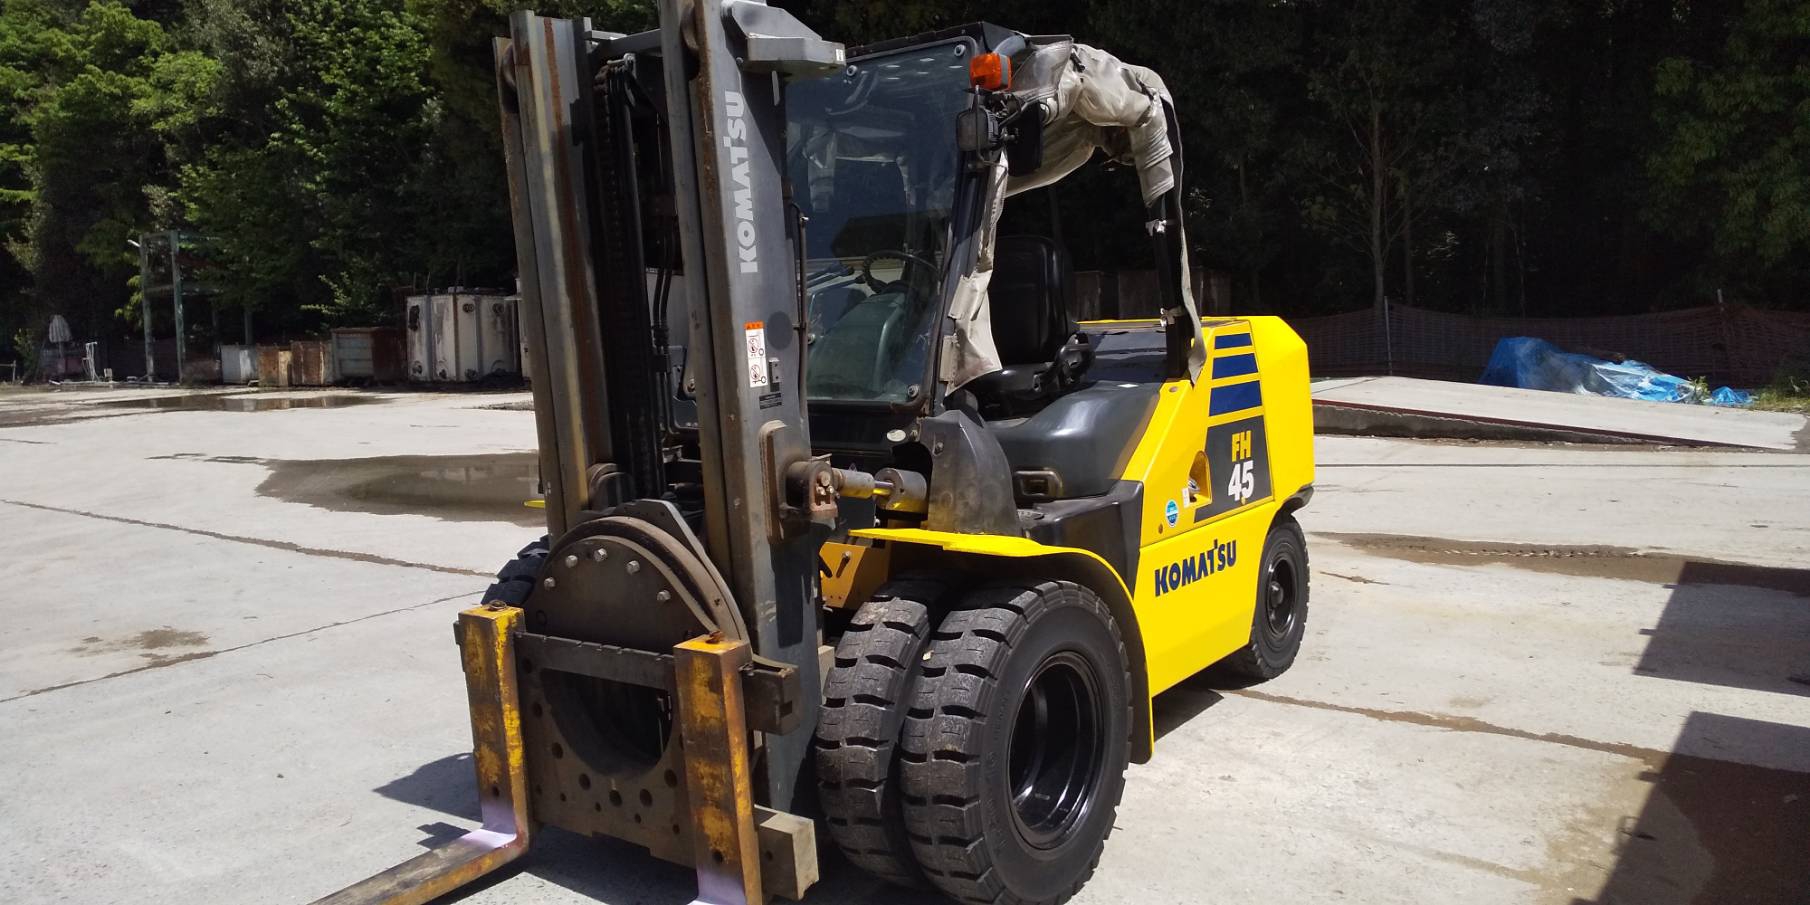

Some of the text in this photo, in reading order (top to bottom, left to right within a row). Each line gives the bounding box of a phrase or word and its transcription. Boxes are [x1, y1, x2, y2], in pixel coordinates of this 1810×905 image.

[723, 90, 758, 274] KOMATSU
[1231, 430, 1252, 463] FH
[1227, 460, 1255, 501] 45
[1154, 538, 1238, 598] KOMATSU
